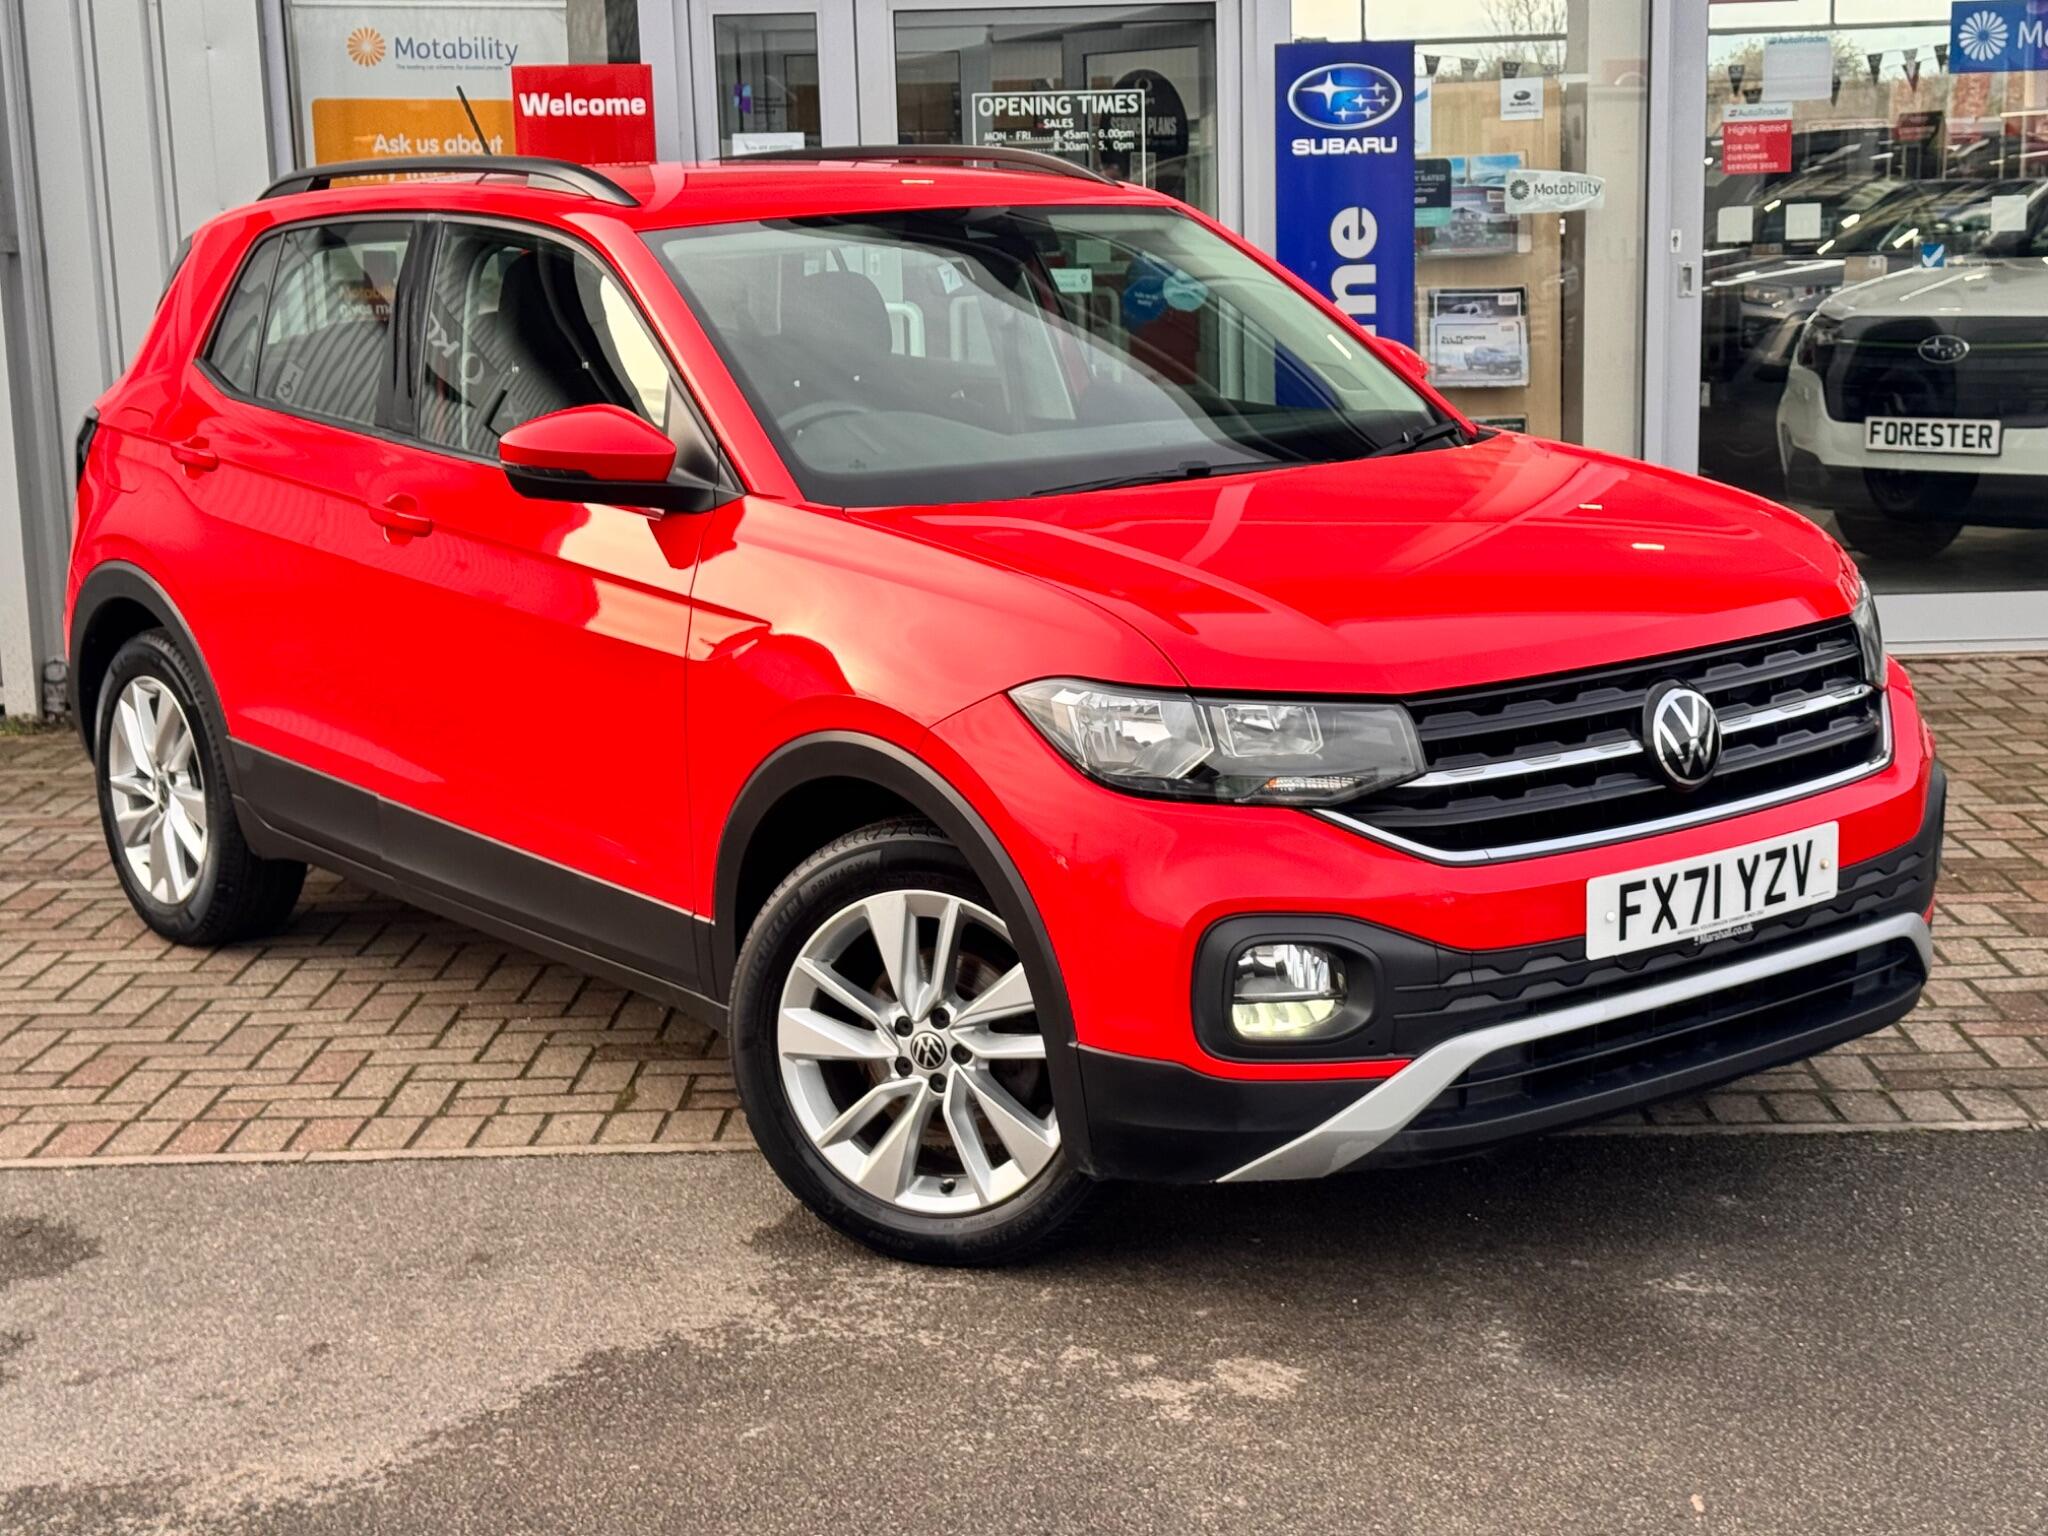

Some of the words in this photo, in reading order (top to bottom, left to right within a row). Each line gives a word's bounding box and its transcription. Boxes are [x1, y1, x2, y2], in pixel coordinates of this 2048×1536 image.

[2017, 20, 2048, 49] M
[395, 36, 518, 66] Motability
[518, 92, 647, 117] Welcome
[978, 96, 1072, 117] OPENING
[1076, 94, 1139, 115] TIMES
[1043, 118, 1074, 129] SALES
[1147, 116, 1177, 136] PLANS
[1727, 125, 1757, 137] Highly
[1758, 123, 1788, 133] Rated
[373, 133, 411, 153] Ask
[416, 138, 439, 153] us
[984, 131, 1007, 141] MON
[1098, 128, 1135, 140] 6.00pm
[1291, 136, 1398, 156] SUBARU
[1533, 181, 1601, 197] Motability
[1870, 421, 1993, 449] FORESTER
[1618, 863, 1722, 942] FX71
[1737, 840, 1813, 912] YZV
